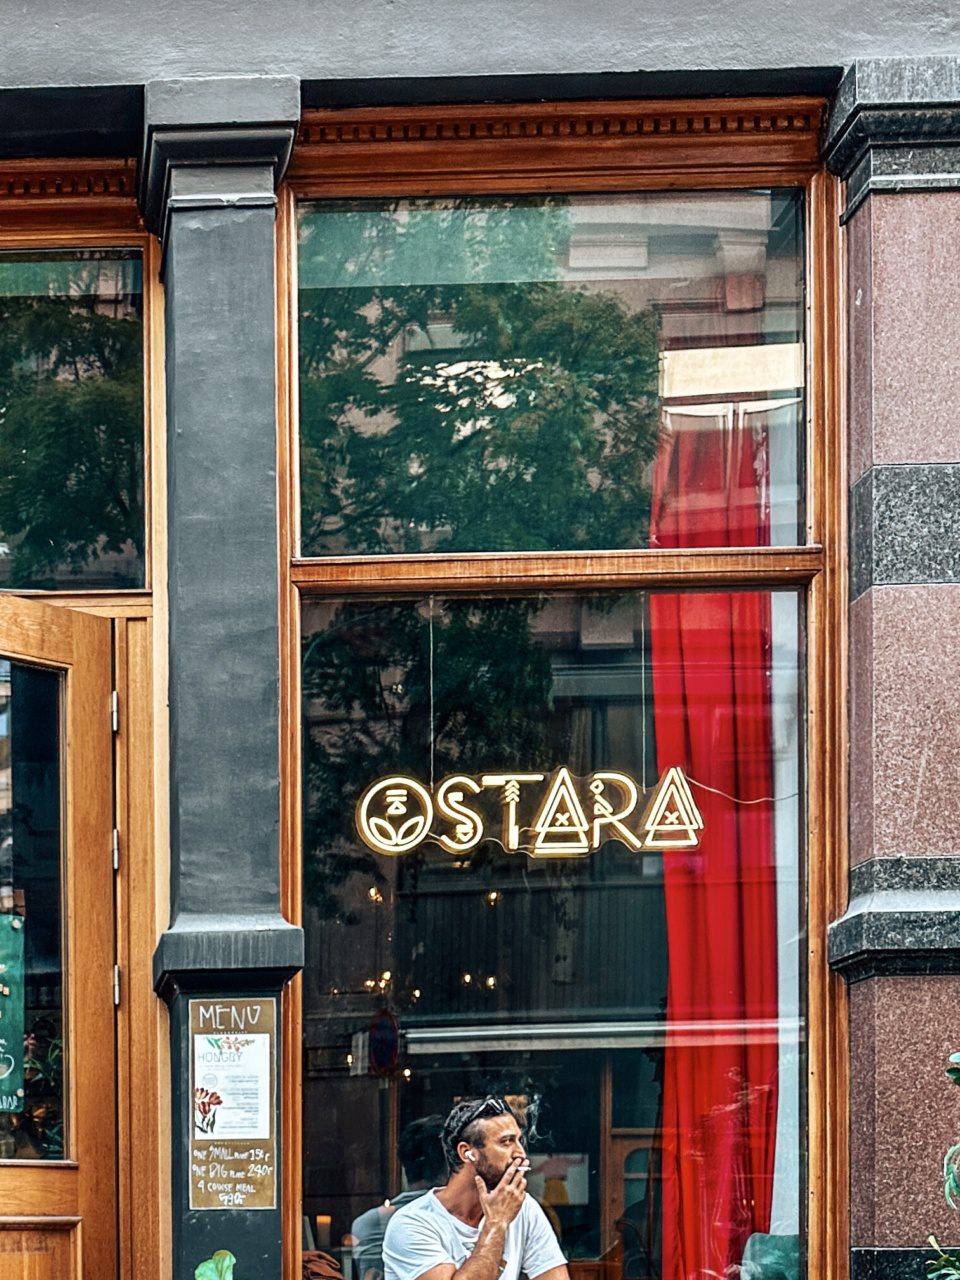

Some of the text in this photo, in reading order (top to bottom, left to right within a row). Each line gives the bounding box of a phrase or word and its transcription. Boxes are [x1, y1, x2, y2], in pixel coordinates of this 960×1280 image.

[360, 767, 704, 853] OSTARA
[199, 1004, 262, 1029] MENU
[209, 1145, 235, 1161] SMALL
[197, 1179, 257, 1194] 4 COURSE MEAL
